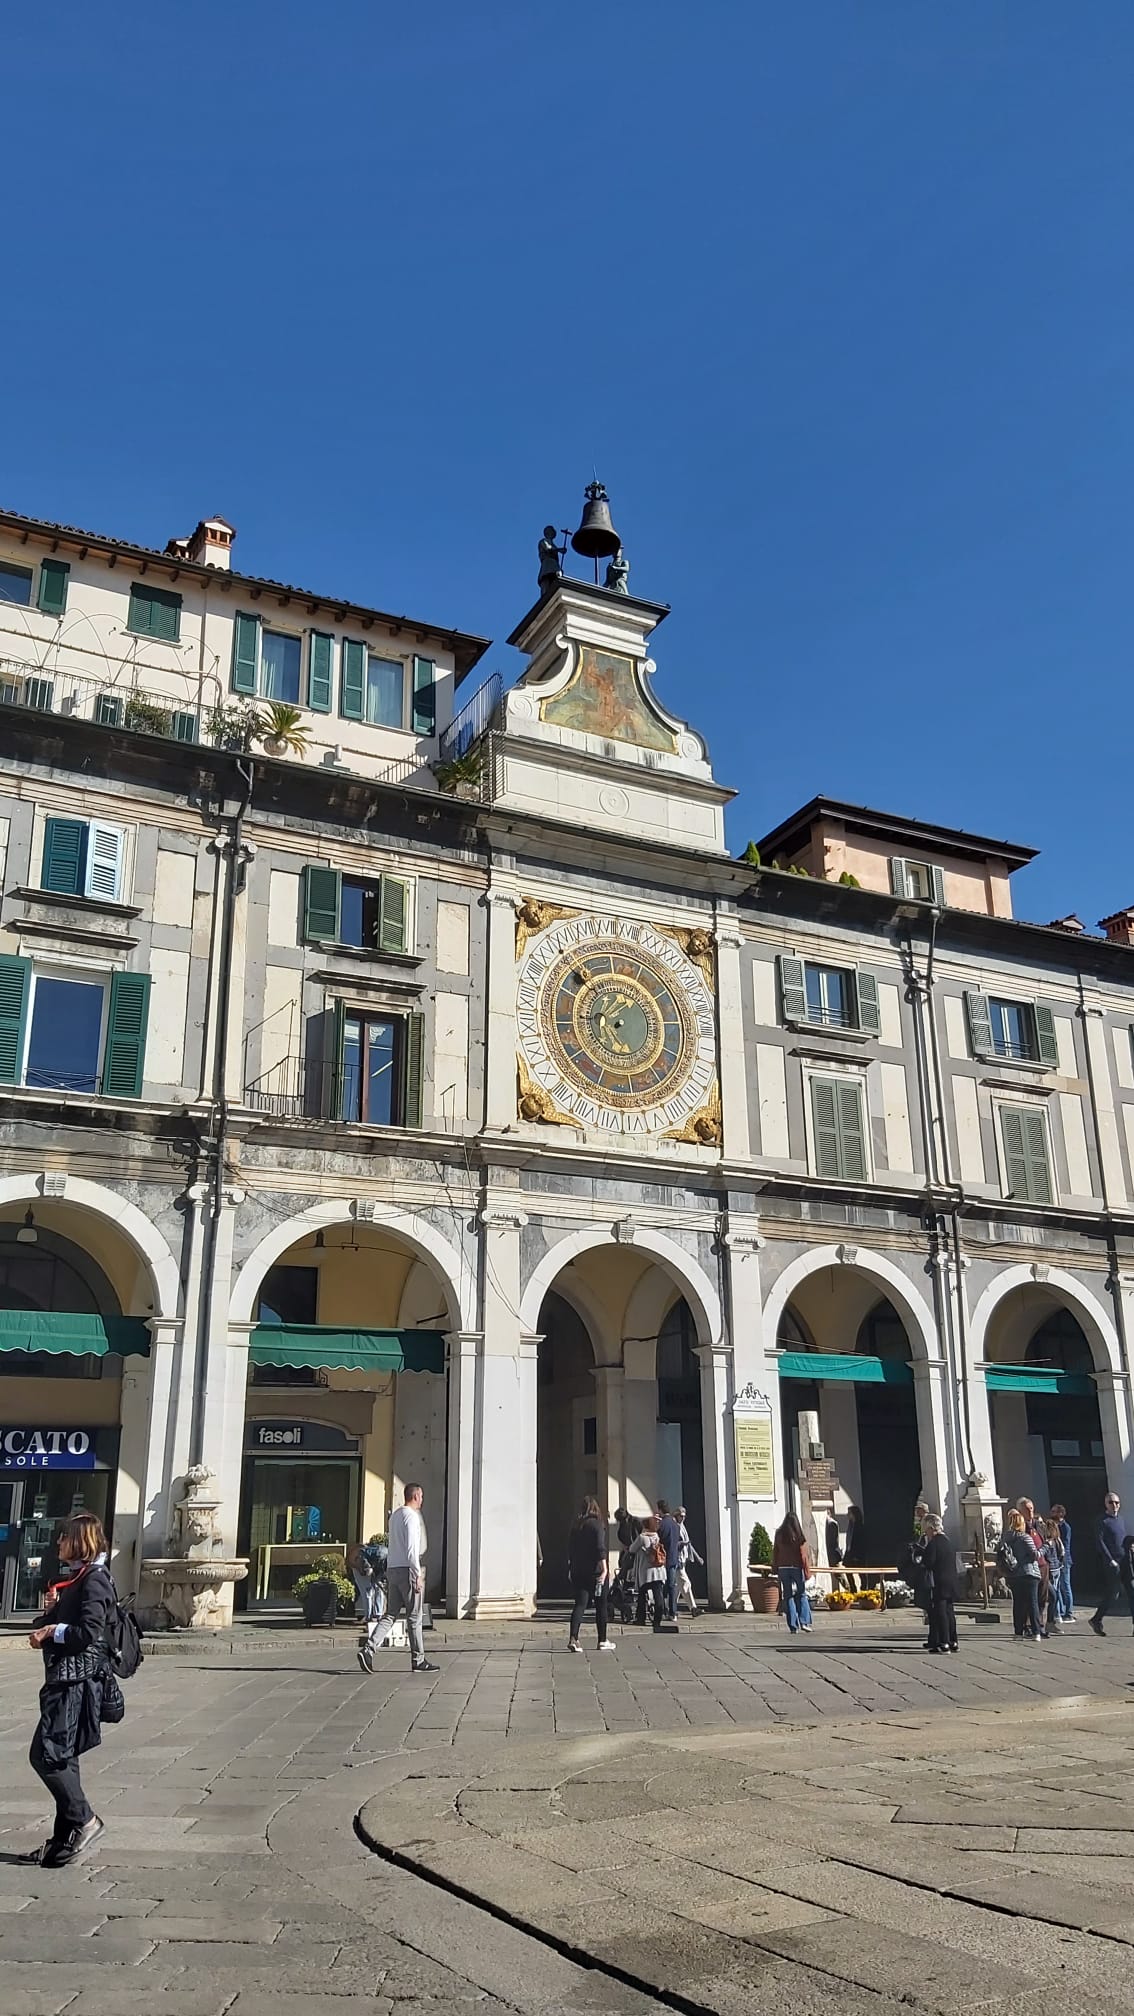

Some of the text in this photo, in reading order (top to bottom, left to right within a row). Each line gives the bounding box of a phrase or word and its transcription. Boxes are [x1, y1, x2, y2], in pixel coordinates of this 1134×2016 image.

[642, 932, 661, 953] XX
[535, 941, 554, 964] XV
[520, 1013, 536, 1032] XII
[525, 1041, 544, 1059] XI
[539, 1066, 556, 1081] X
[695, 1065, 710, 1080] II
[684, 1084, 700, 1103] III
[601, 1112, 620, 1131] VII
[628, 1115, 643, 1131] VI
[654, 1112, 664, 1129] V
[0, 1430, 90, 1455] CATO
[259, 1427, 301, 1443] fasoli
[4, 1456, 49, 1466] SOLE
